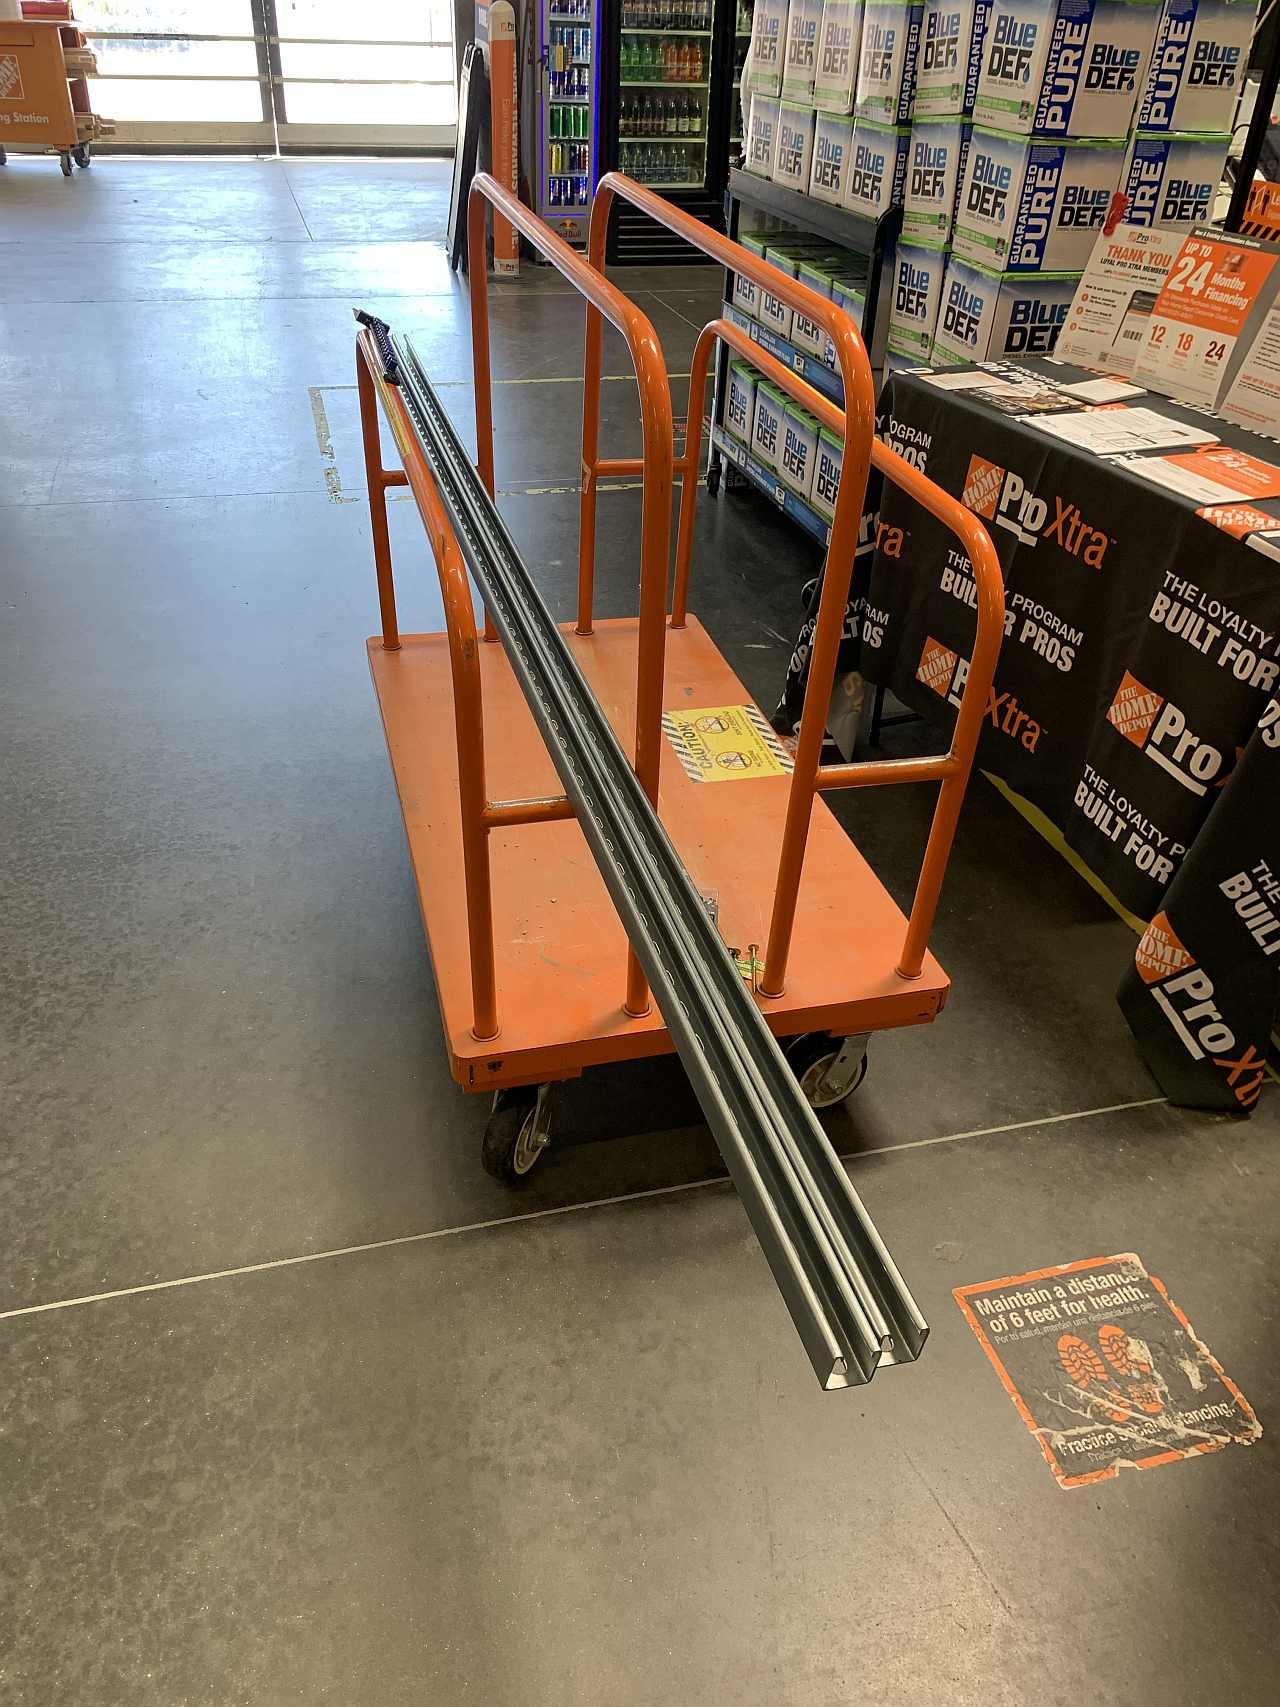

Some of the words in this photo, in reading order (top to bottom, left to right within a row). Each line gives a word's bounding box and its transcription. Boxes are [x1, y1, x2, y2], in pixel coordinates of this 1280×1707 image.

[791, 16, 816, 39] Blue
[865, 24, 895, 51] Blue
[927, 12, 961, 39] Blue
[994, 15, 1038, 48] Blue
[789, 40, 814, 65] DEF
[862, 50, 892, 79] DEF
[924, 38, 958, 70] DEF
[966, 4, 985, 107] GUARANTEED
[988, 46, 1032, 80] DEF
[1090, 44, 1141, 67] Blue
[1194, 41, 1240, 63] Blue
[899, 25, 919, 119] GUARANTEED
[1035, 19, 1066, 128] GUARANTEED
[1045, 22, 1088, 129] PURE
[1085, 66, 1136, 90] DEF
[1148, 20, 1191, 125] PURE
[1187, 63, 1236, 86] DEF
[13, 111, 49, 124] Station
[781, 125, 804, 152] Blue
[817, 136, 842, 164] Blue
[779, 147, 802, 174] DEF
[855, 145, 884, 175] Blue
[914, 143, 947, 168] Blue
[814, 160, 840, 188] DEF
[852, 169, 881, 200] DEF
[891, 152, 906, 208] ANTEED
[911, 169, 945, 197] DEF
[973, 154, 1012, 189] Blue
[967, 182, 1007, 218] DEF
[1063, 186, 1111, 205] Blue
[1130, 161, 1163, 226] URE
[1167, 180, 1212, 199] Blue
[1010, 165, 1037, 264] GUARANTEED
[1020, 168, 1059, 264] PURE
[1057, 206, 1107, 227] DEF
[1161, 200, 1209, 221] DEF
[1107, 244, 1144, 263] THANK
[1148, 252, 1172, 268] YOU
[1185, 241, 1199, 254] UP
[1200, 245, 1213, 258] TO
[899, 262, 930, 291] Blue
[1166, 256, 1214, 296] 24
[1210, 272, 1246, 291] Months
[896, 286, 928, 317] DEF
[949, 280, 984, 318] Blue
[1010, 300, 1071, 325] Blue
[1203, 286, 1249, 311] Financing
[943, 305, 979, 342] DEF
[1150, 323, 1167, 343] 12
[1177, 332, 1194, 351] 18
[1205, 340, 1227, 361] 24
[759, 404, 778, 435] Blue
[756, 422, 776, 455] DEF
[786, 428, 807, 460] Blue
[783, 446, 805, 477] DEF
[820, 453, 841, 485] Blu
[999, 471, 1048, 532] Pro
[1043, 495, 1108, 570] Xtra
[948, 550, 972, 573] THE
[940, 567, 978, 610] BUIL
[1011, 593, 1084, 646] PROGRAM
[1163, 570, 1199, 603] THE
[1198, 593, 1273, 649] LOYALTY
[1019, 619, 1076, 672] PROS
[1149, 591, 1221, 654] BUILT
[1217, 638, 1280, 691] FOR
[1109, 692, 1161, 725] HOME
[1119, 686, 1137, 701] THE
[985, 686, 1040, 753] Xtra
[1119, 714, 1152, 735] DEPOT
[1151, 702, 1222, 781] Pro
[1083, 763, 1109, 796] THE
[1108, 789, 1169, 847] LOYALTY
[1074, 780, 1128, 842] BUILT
[1122, 832, 1174, 885] FOR
[1252, 859, 1280, 904] THE
[1163, 967, 1236, 1053] Pro
[975, 1288, 1052, 1316] Maintain
[1053, 1284, 1066, 1299] a
[989, 1317, 1009, 1333] of
[1008, 1312, 1025, 1328] 6
[1024, 1305, 1063, 1325] feet
[1061, 1298, 1088, 1317] for
[1088, 1284, 1150, 1310] health.
